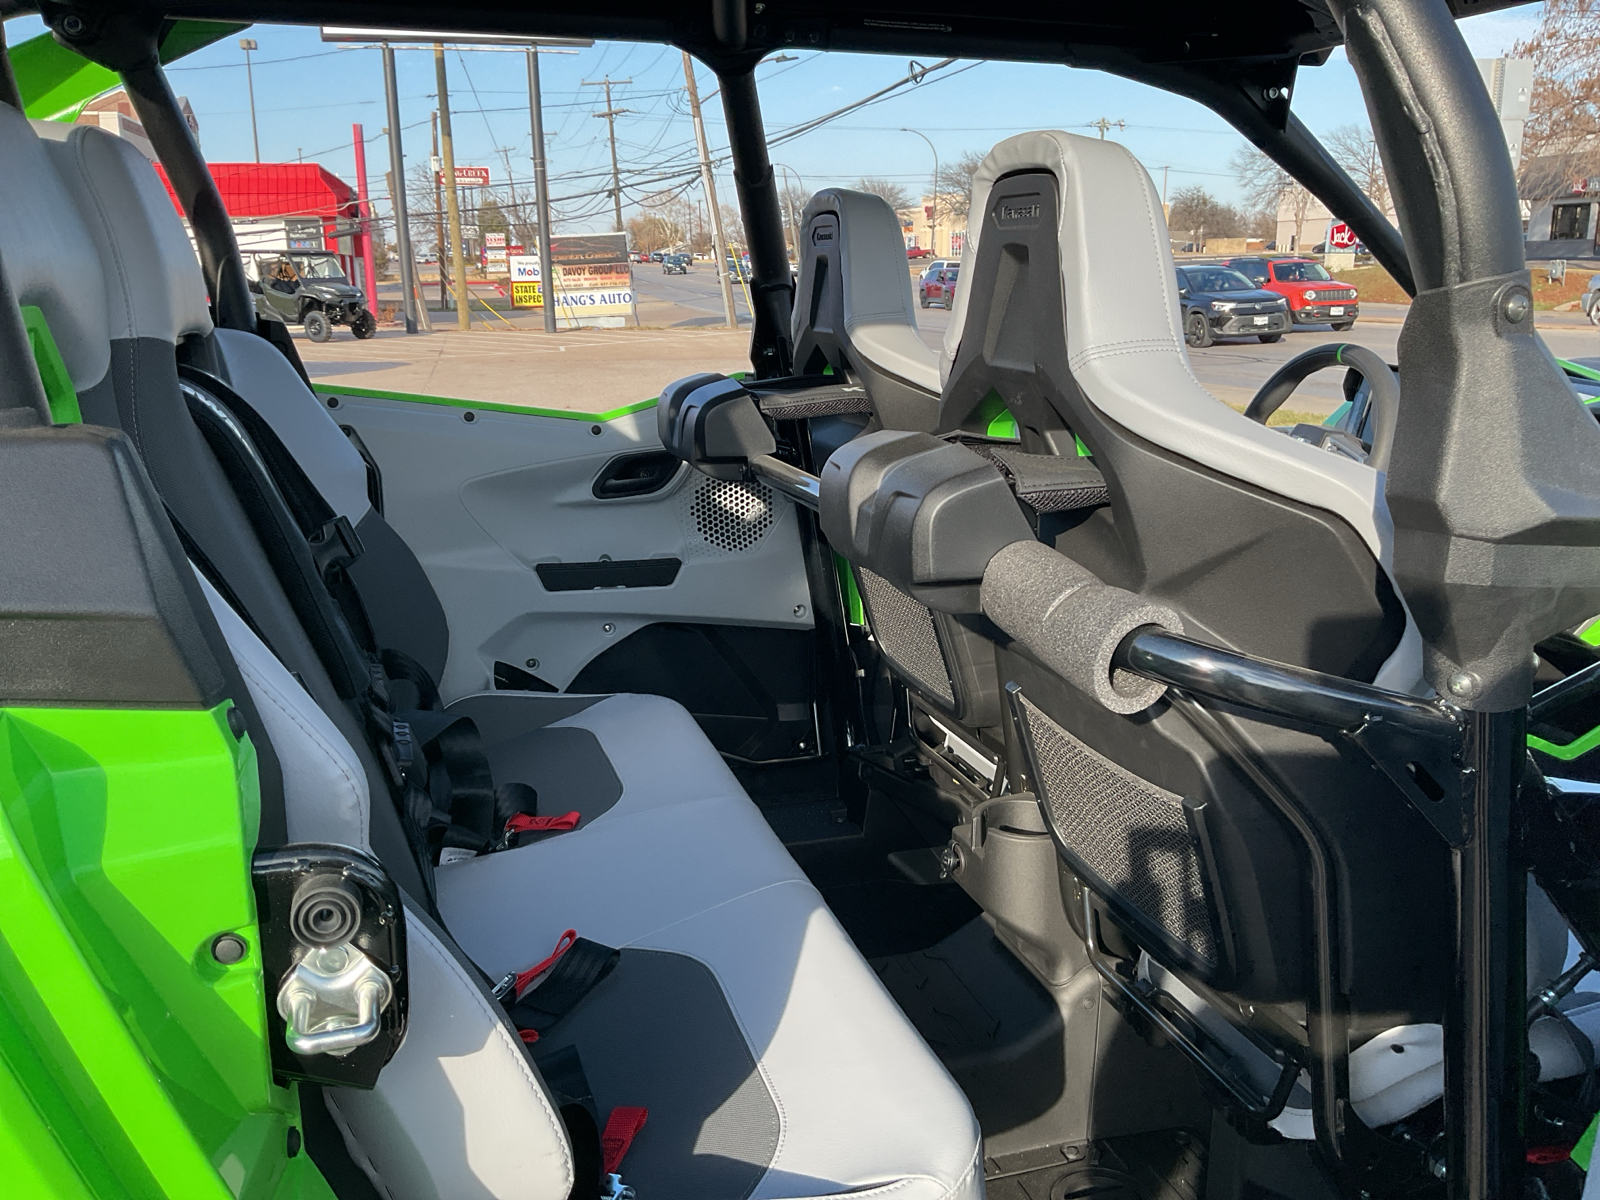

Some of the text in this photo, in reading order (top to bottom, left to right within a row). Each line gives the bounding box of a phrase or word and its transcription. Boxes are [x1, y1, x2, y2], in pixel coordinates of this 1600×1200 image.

[1331, 225, 1356, 246] Jack
[517, 267, 540, 276] Mob
[562, 264, 630, 277] DAVOY GROUP LLC
[515, 285, 537, 294] STATE
[515, 295, 542, 303] INSPEC
[554, 293, 632, 307] HANG'S AUTO
